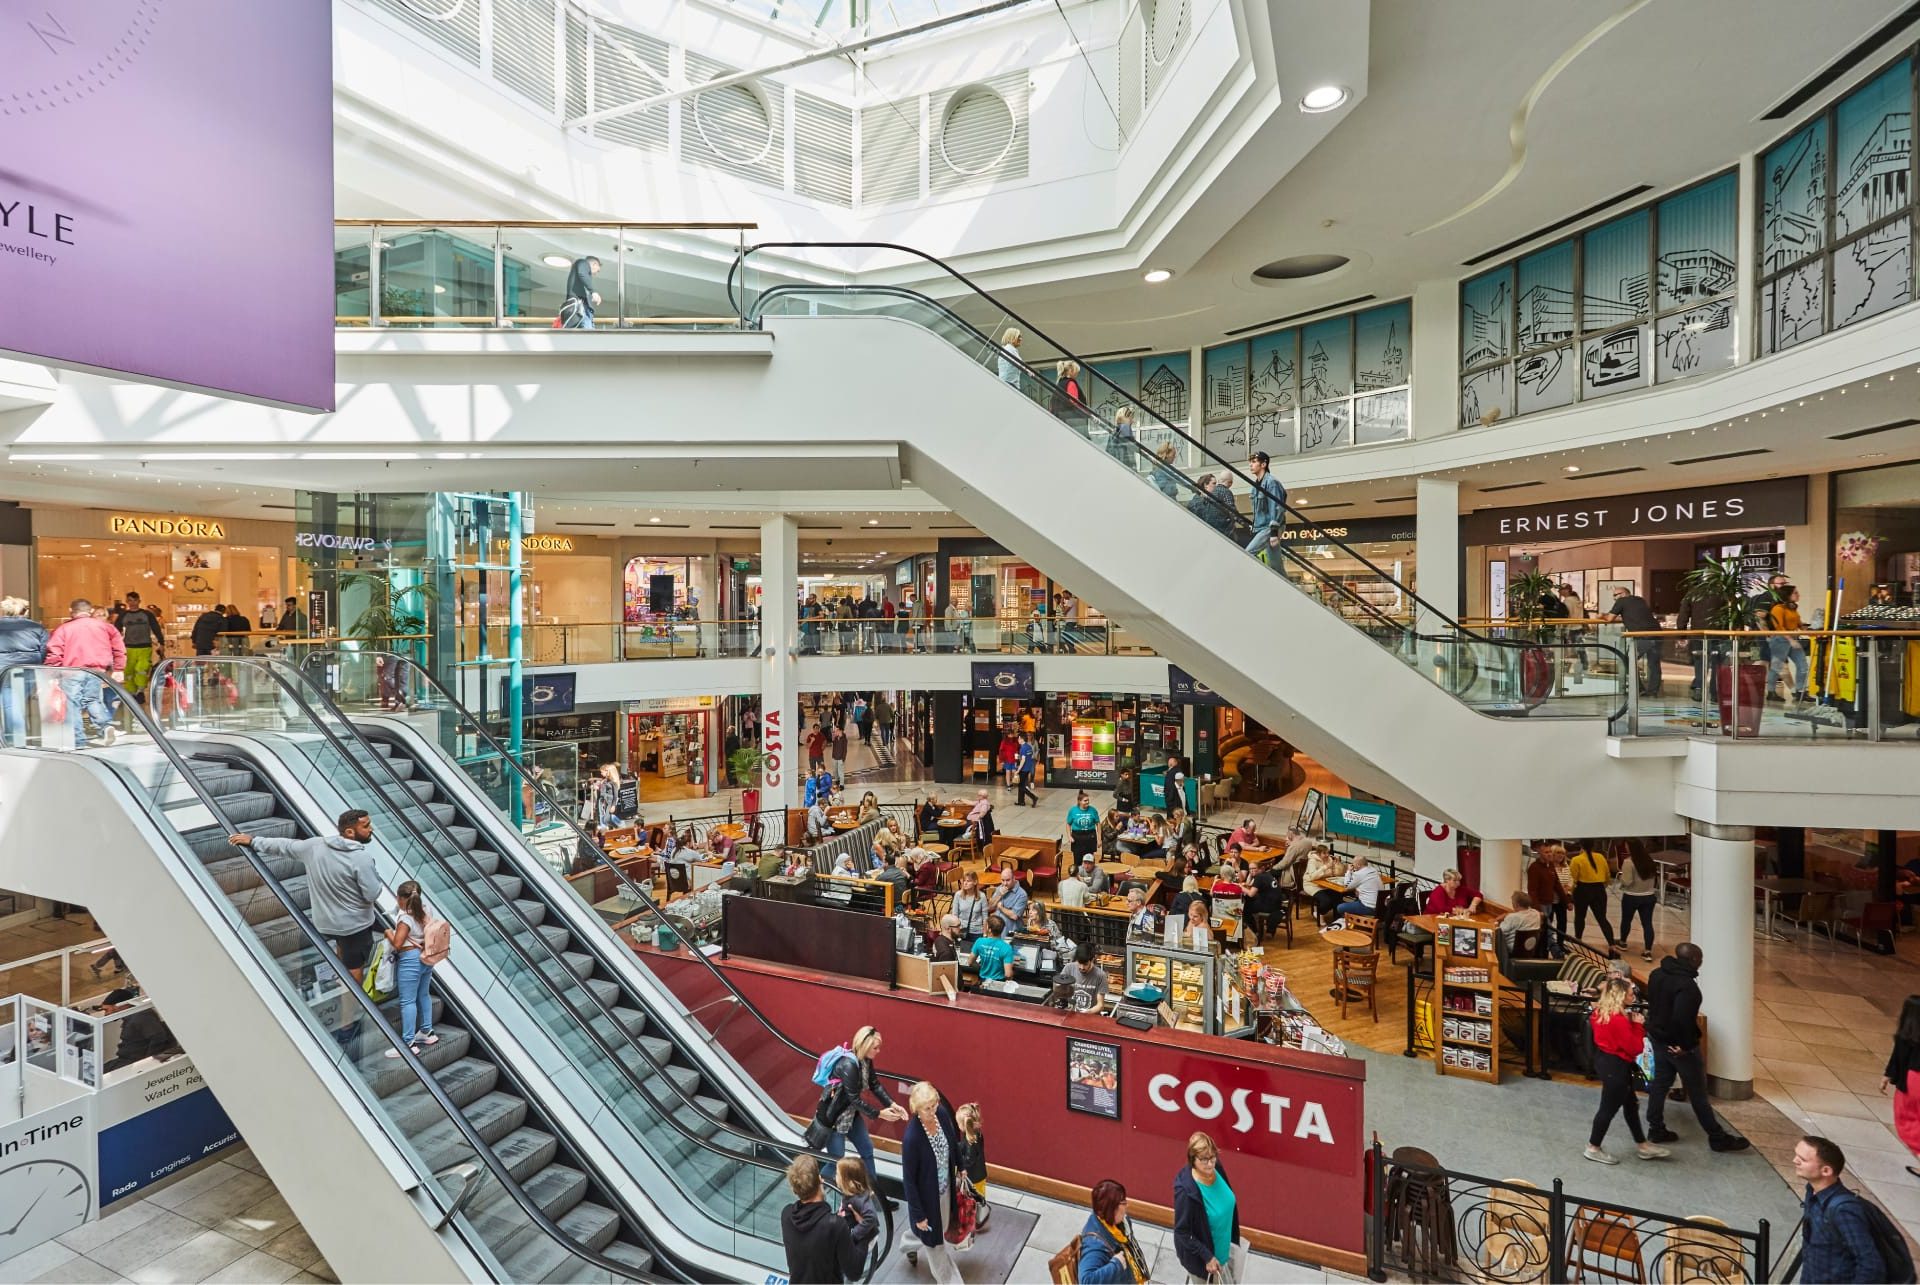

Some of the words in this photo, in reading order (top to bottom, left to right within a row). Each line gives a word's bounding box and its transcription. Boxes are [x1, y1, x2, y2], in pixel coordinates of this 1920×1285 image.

[1500, 510, 1609, 534] ERNEST
[1631, 498, 1745, 524] JONES
[500, 536, 572, 550] PNDORA
[765, 710, 782, 787] COSTA
[1074, 770, 1108, 779] JESSOPS
[144, 1064, 195, 1090] Jewellery
[144, 1083, 180, 1103] Watch
[1148, 1073, 1335, 1144] COSTA
[112, 1181, 138, 1198] Rado
[150, 1154, 191, 1179] Longines
[202, 1132, 237, 1154] Accurist
